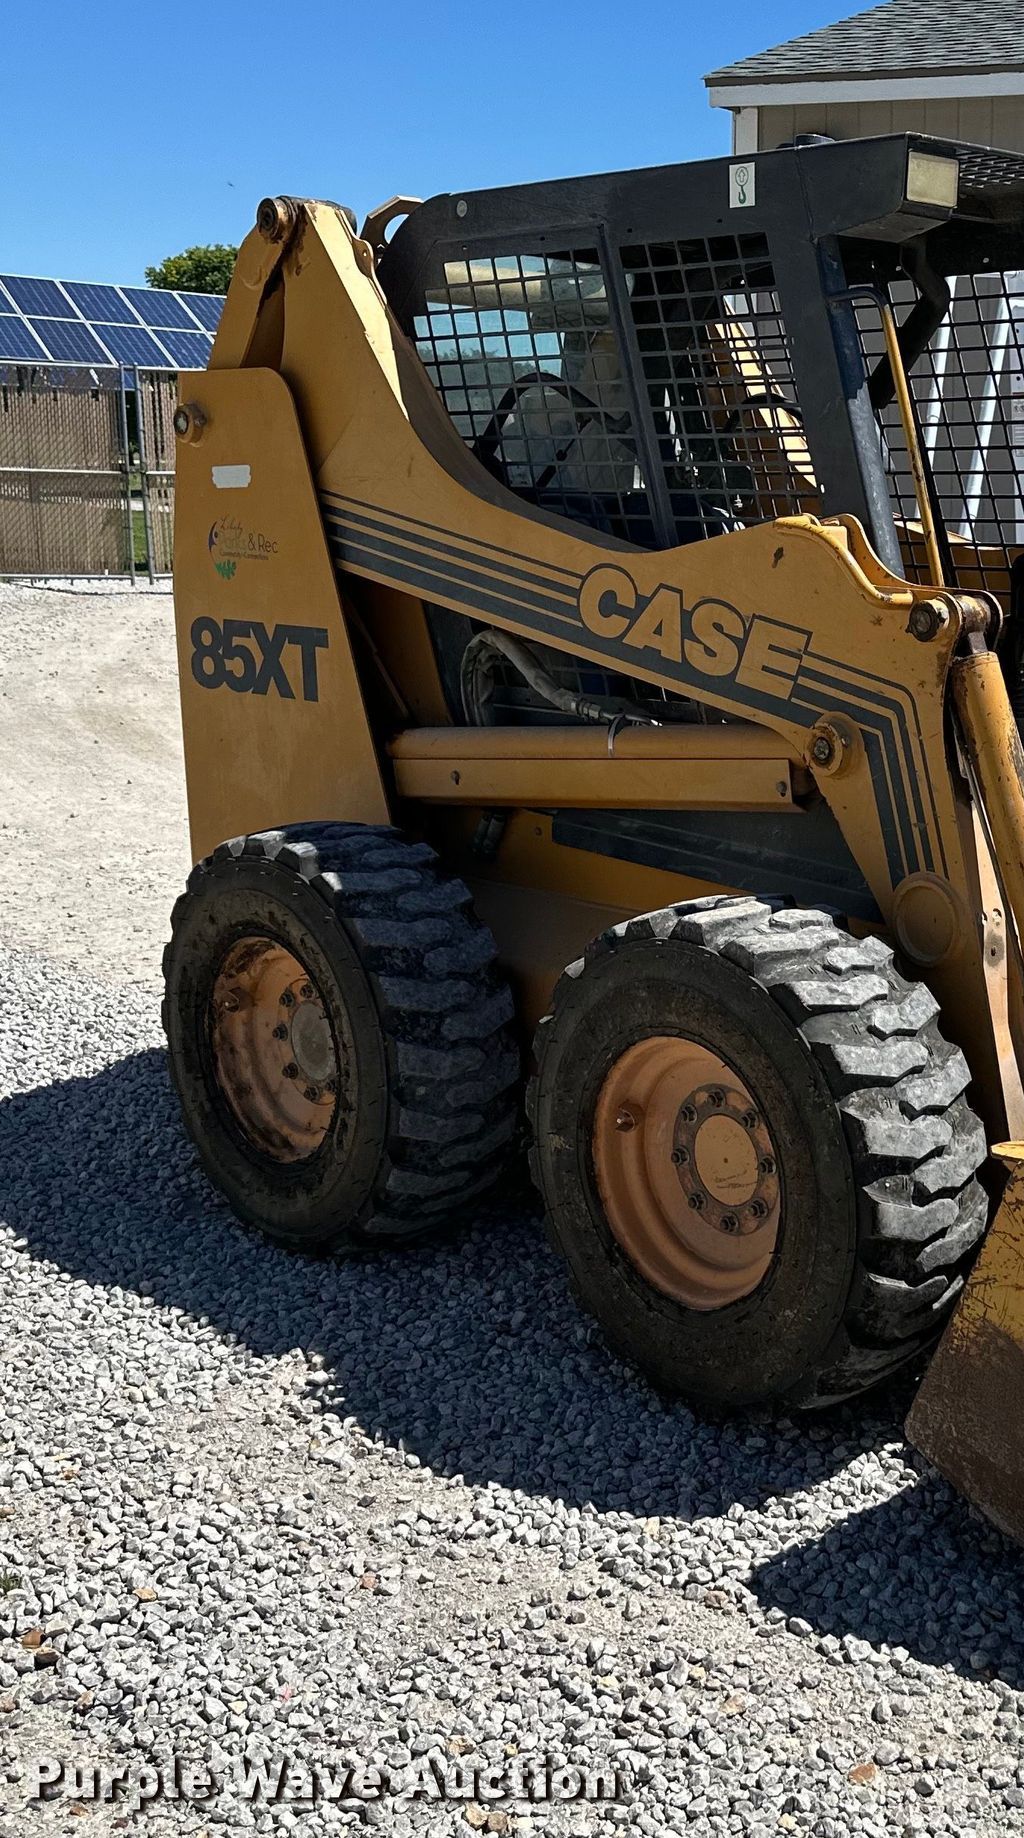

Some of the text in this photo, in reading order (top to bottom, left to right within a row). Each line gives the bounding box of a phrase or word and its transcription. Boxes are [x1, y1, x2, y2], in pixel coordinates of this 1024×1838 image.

[248, 533, 256, 551] &
[258, 533, 278, 553] Rec
[190, 616, 329, 702] 85XT
[579, 562, 813, 701] CASE
